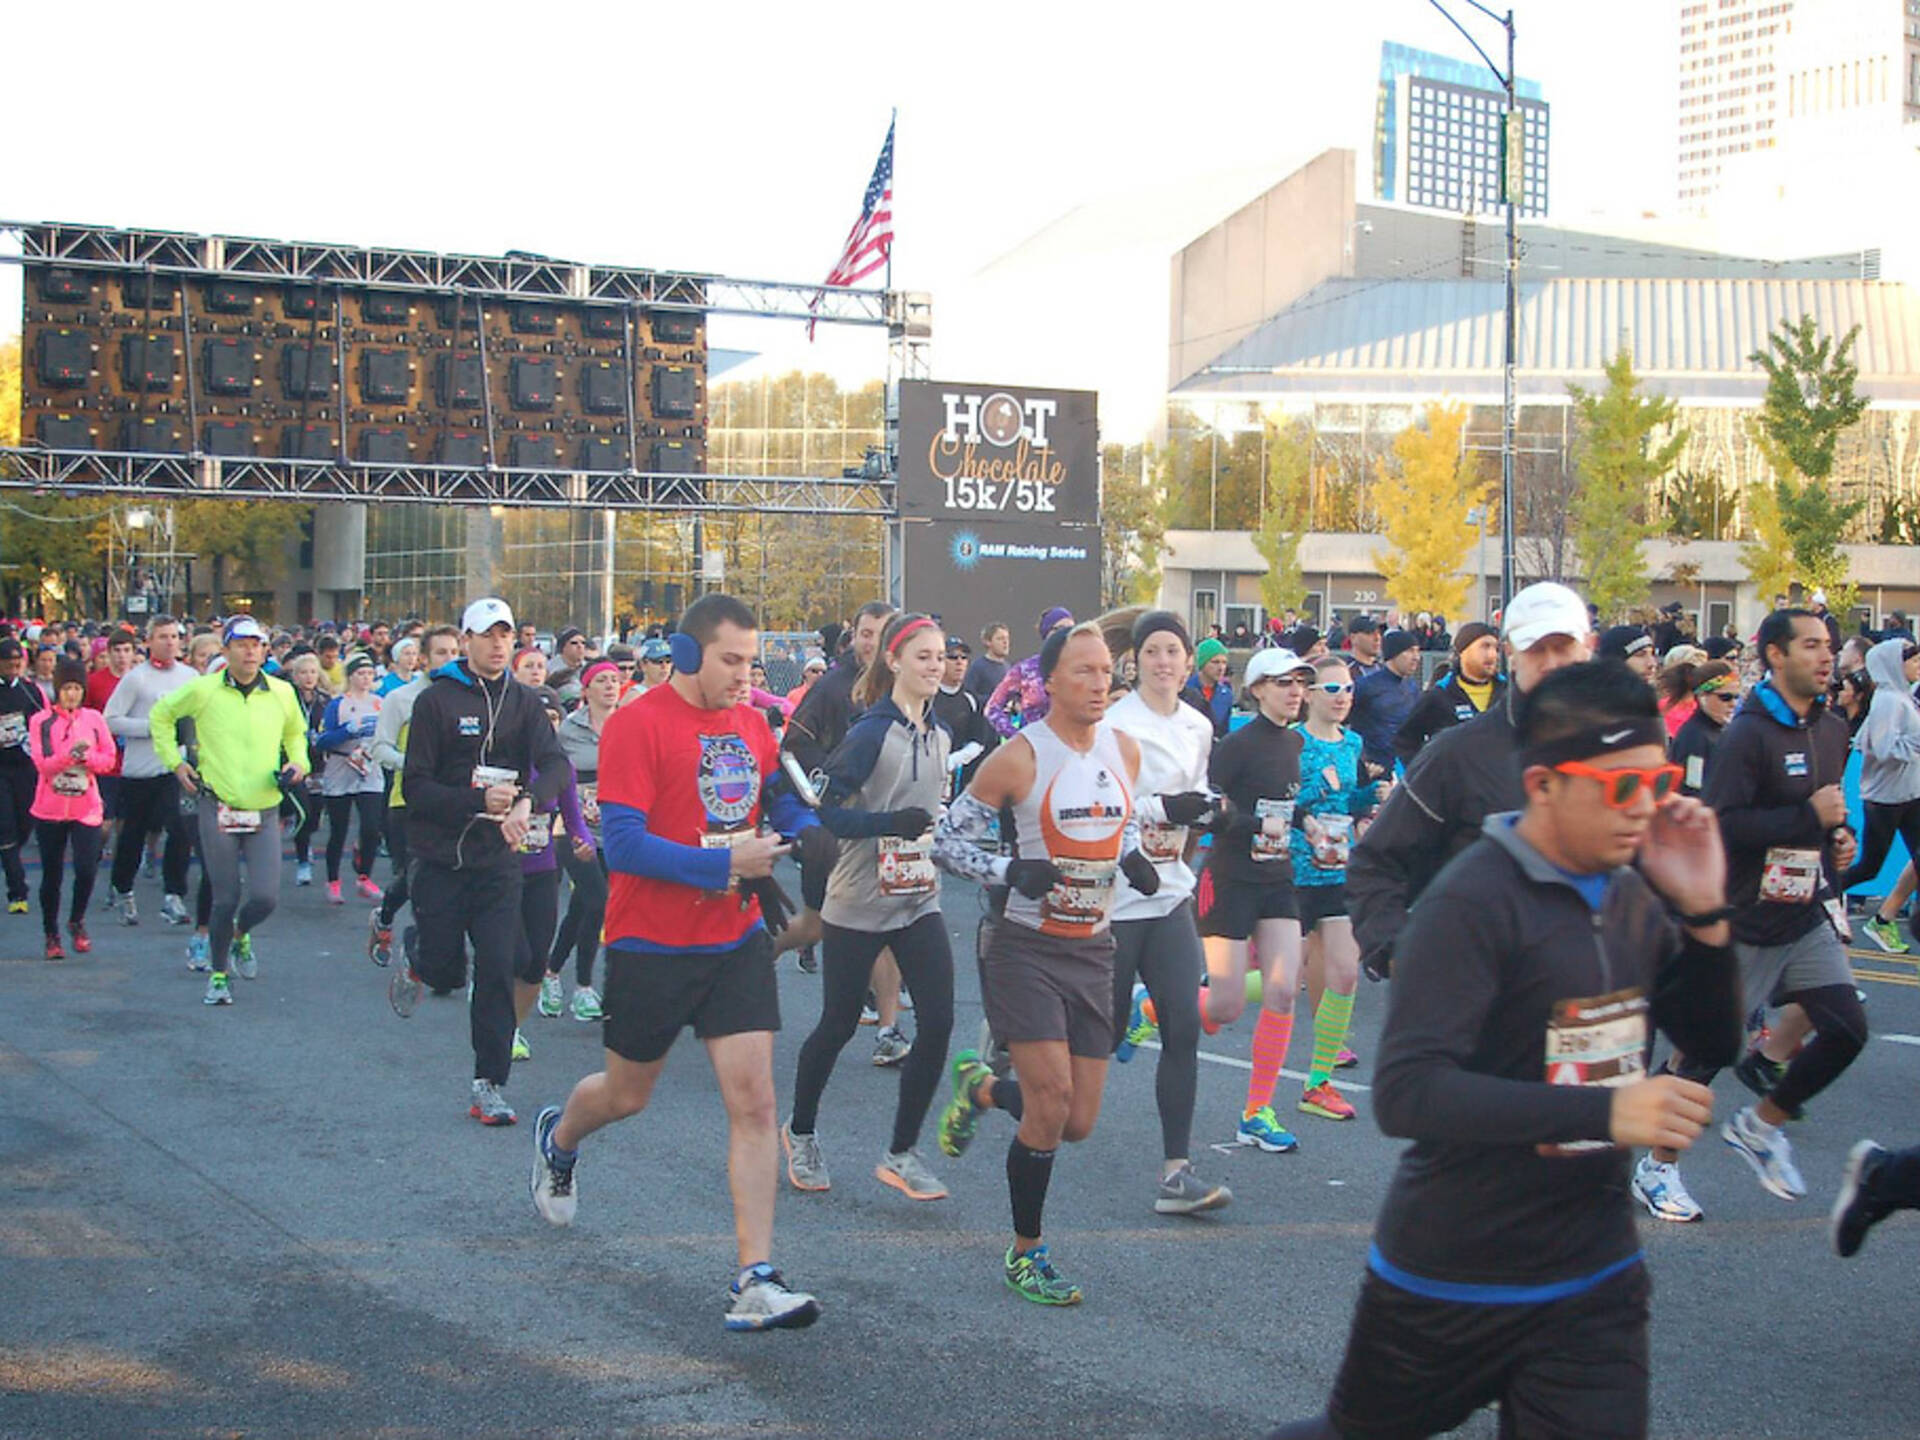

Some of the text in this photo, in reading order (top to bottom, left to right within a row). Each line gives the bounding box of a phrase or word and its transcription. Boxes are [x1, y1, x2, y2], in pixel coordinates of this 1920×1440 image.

[942, 393, 1056, 447] HOT
[929, 428, 1066, 484] Chocolate
[944, 477, 1056, 511] 15k/5k
[980, 544, 1086, 561] RAM Racing Series
[1353, 590, 1377, 602] 230
[702, 741, 757, 769] CHICAGO
